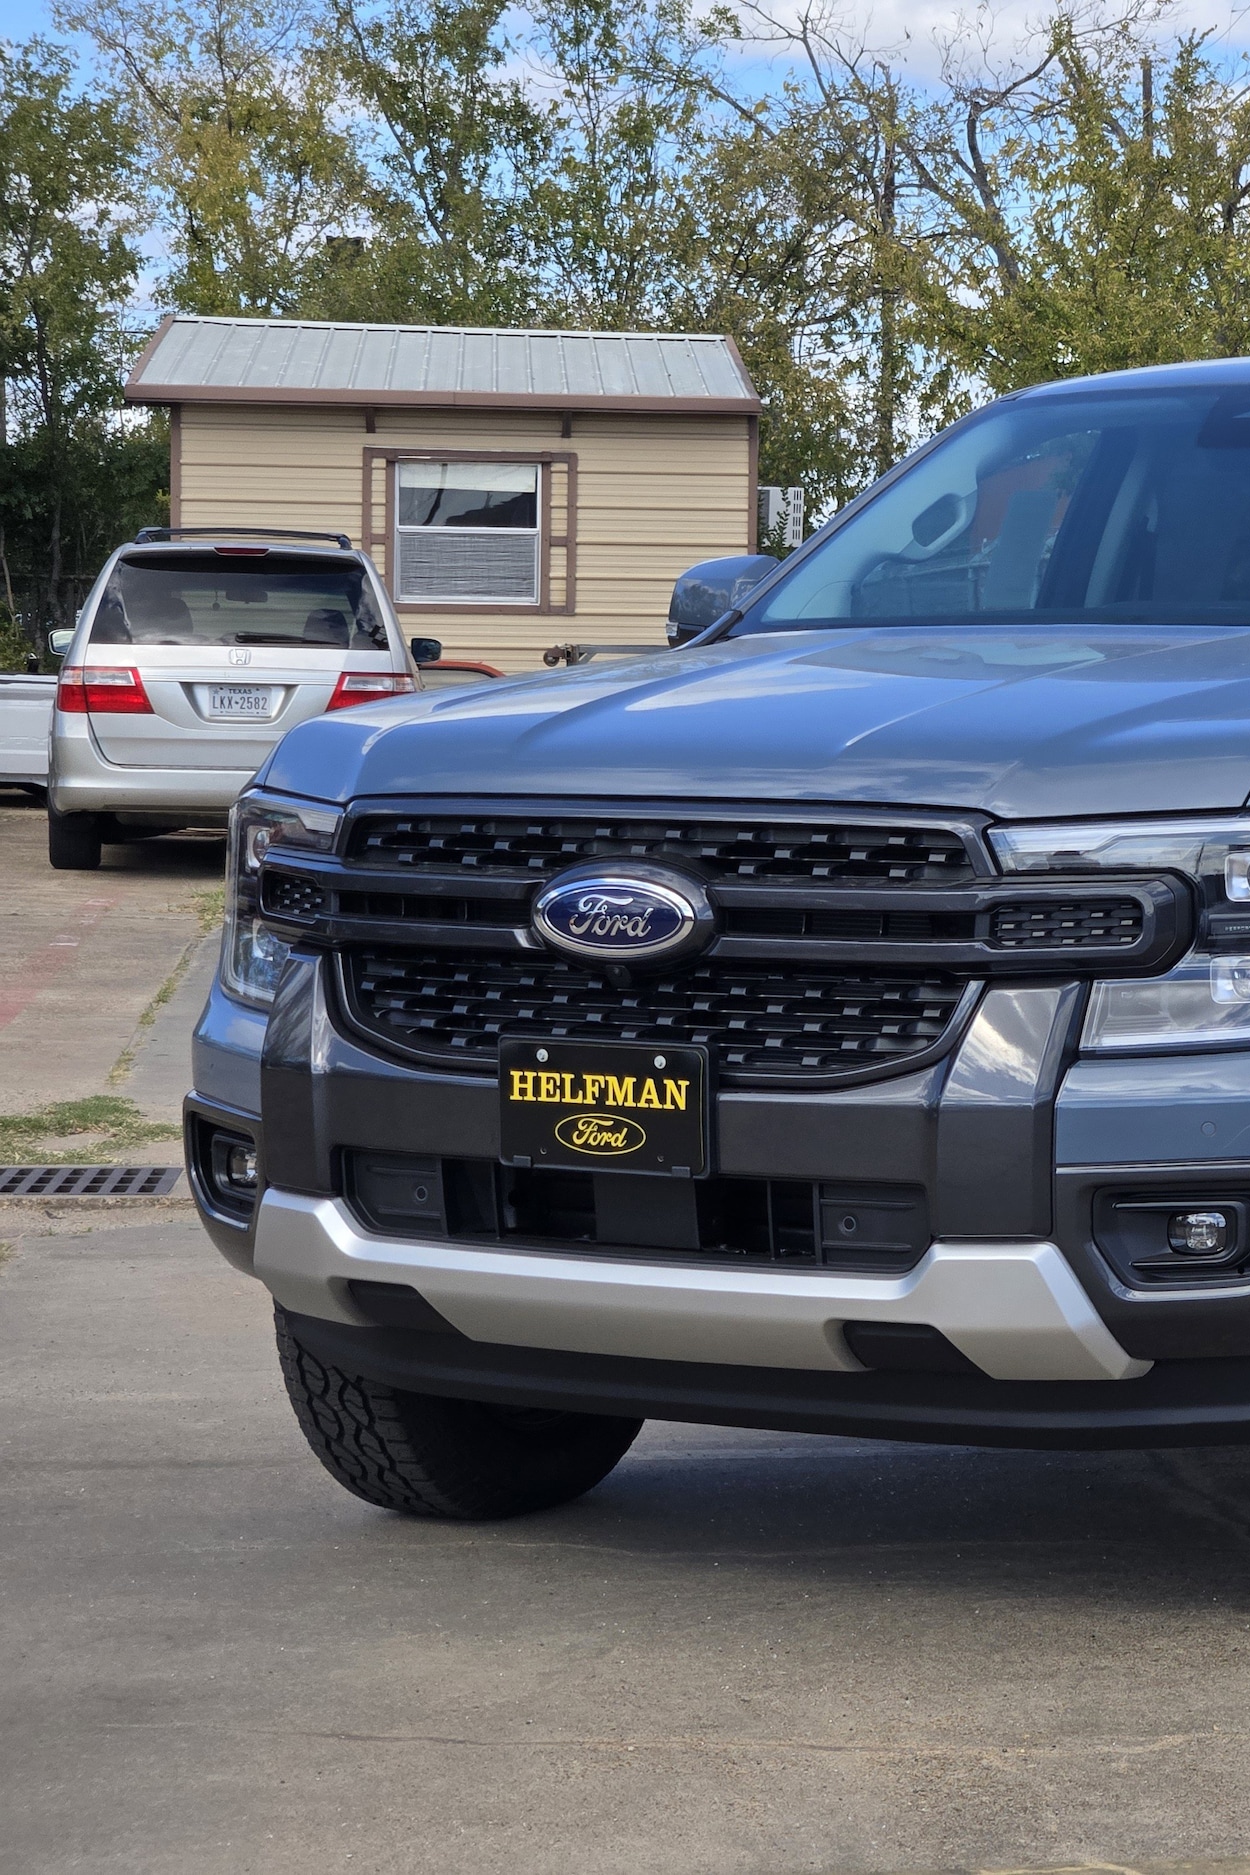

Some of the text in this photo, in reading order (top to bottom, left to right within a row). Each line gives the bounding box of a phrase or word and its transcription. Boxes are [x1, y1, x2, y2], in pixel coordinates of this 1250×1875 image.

[569, 893, 654, 938] Ford
[509, 1070, 690, 1111] HELFMAN
[572, 1117, 628, 1148] Ford
